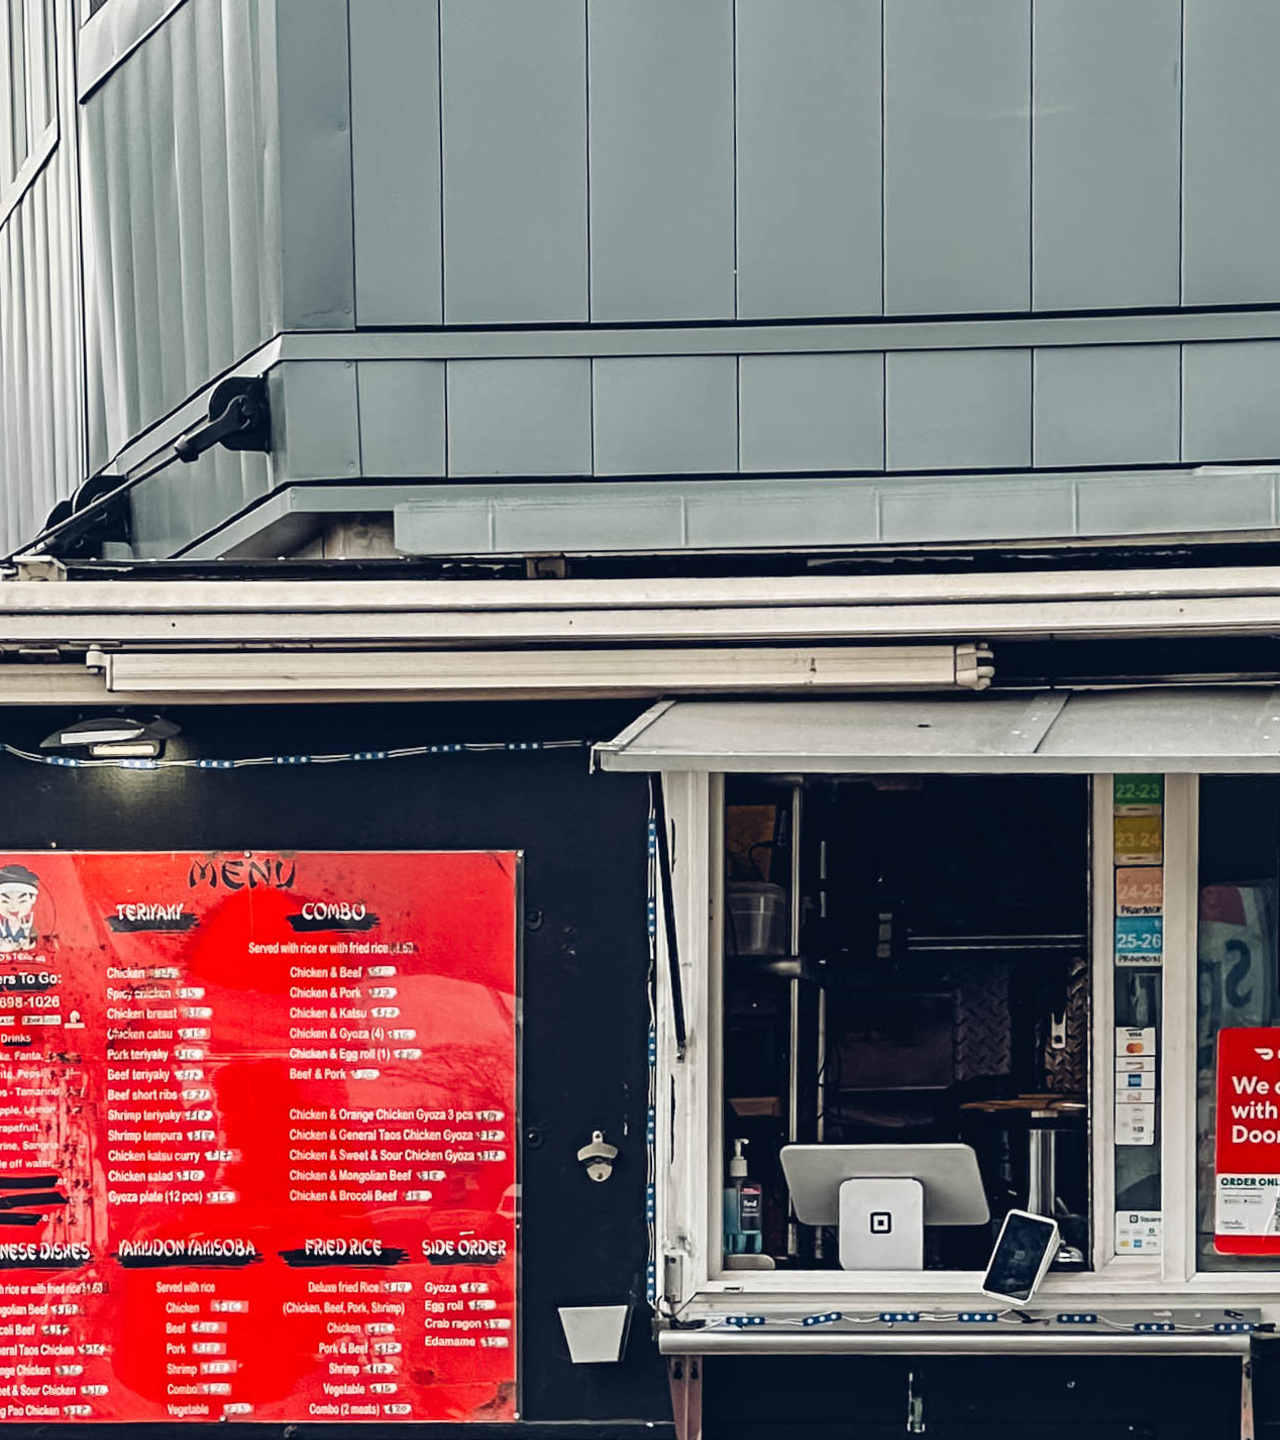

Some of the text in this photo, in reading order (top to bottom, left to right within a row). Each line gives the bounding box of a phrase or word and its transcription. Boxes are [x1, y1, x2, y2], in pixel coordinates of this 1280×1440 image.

[1116, 783, 1160, 799] 22-23
[189, 859, 296, 889] MENU
[302, 902, 366, 921] COMBO
[1117, 933, 1162, 949] 25-26
[18, 972, 39, 984] To
[39, 971, 62, 984] Go:
[1, 1033, 32, 1043] Drinks
[1232, 1076, 1270, 1095] We
[1231, 1101, 1278, 1119] with
[1221, 1178, 1257, 1186] ORDER
[39, 1243, 90, 1260] DISHES
[187, 1239, 256, 1256] YAKISOBA
[305, 1239, 382, 1257] FRIED RICE
[422, 1239, 507, 1256] SIDE ORDER
[424, 1336, 476, 1347] Edamame
